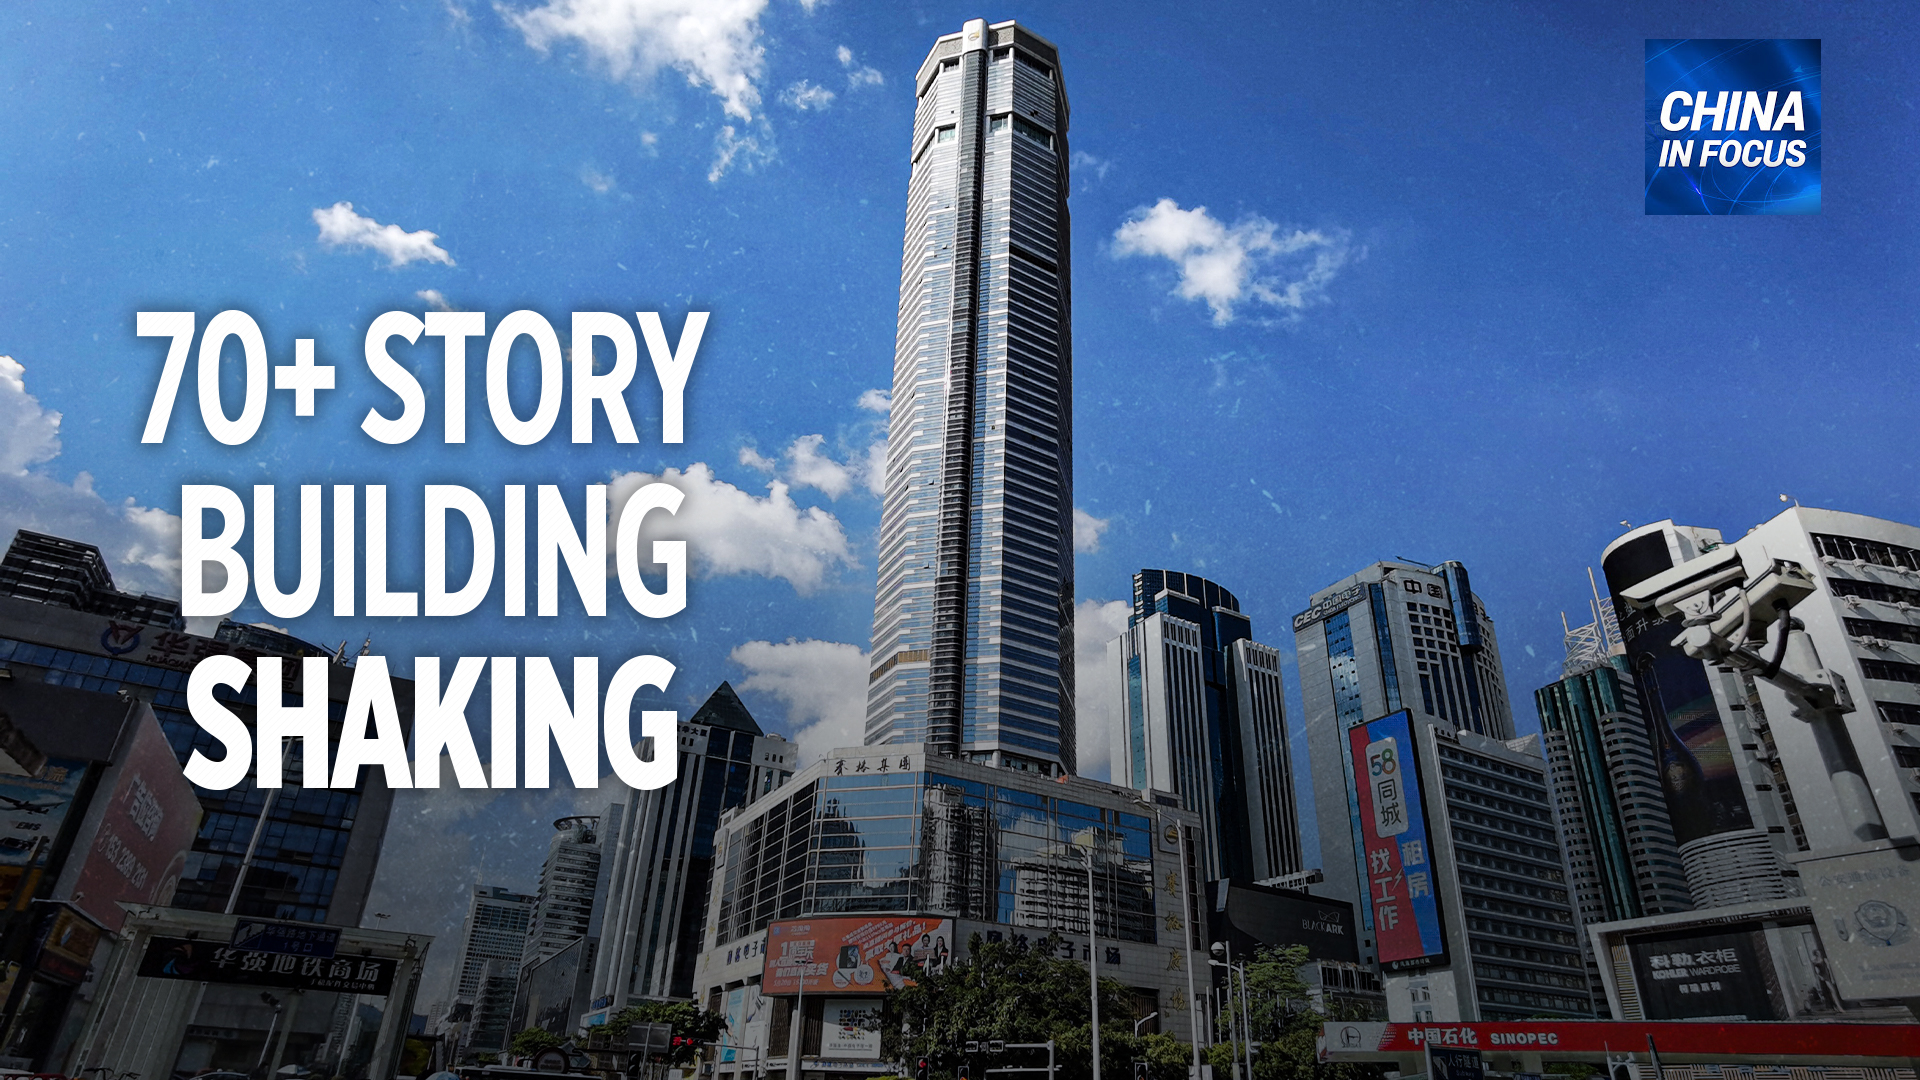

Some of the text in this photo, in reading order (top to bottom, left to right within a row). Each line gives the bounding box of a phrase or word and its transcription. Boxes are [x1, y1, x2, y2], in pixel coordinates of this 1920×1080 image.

[1322, 585, 1361, 610] 中国电子
[1294, 605, 1322, 628] CEC
[15, 821, 42, 831] EMS
[1401, 839, 1431, 900] 租房
[1370, 847, 1399, 932] 找工作
[210, 947, 381, 983] 华强地铁商场
[1648, 947, 1739, 969] 科勒衣柜
[1652, 963, 1742, 980] KOHLER WARDROBE
[1407, 1027, 1479, 1046] 中国石化
[1490, 1031, 1559, 1046] SINOPEC
[1447, 1053, 1479, 1069] 人行隧道
